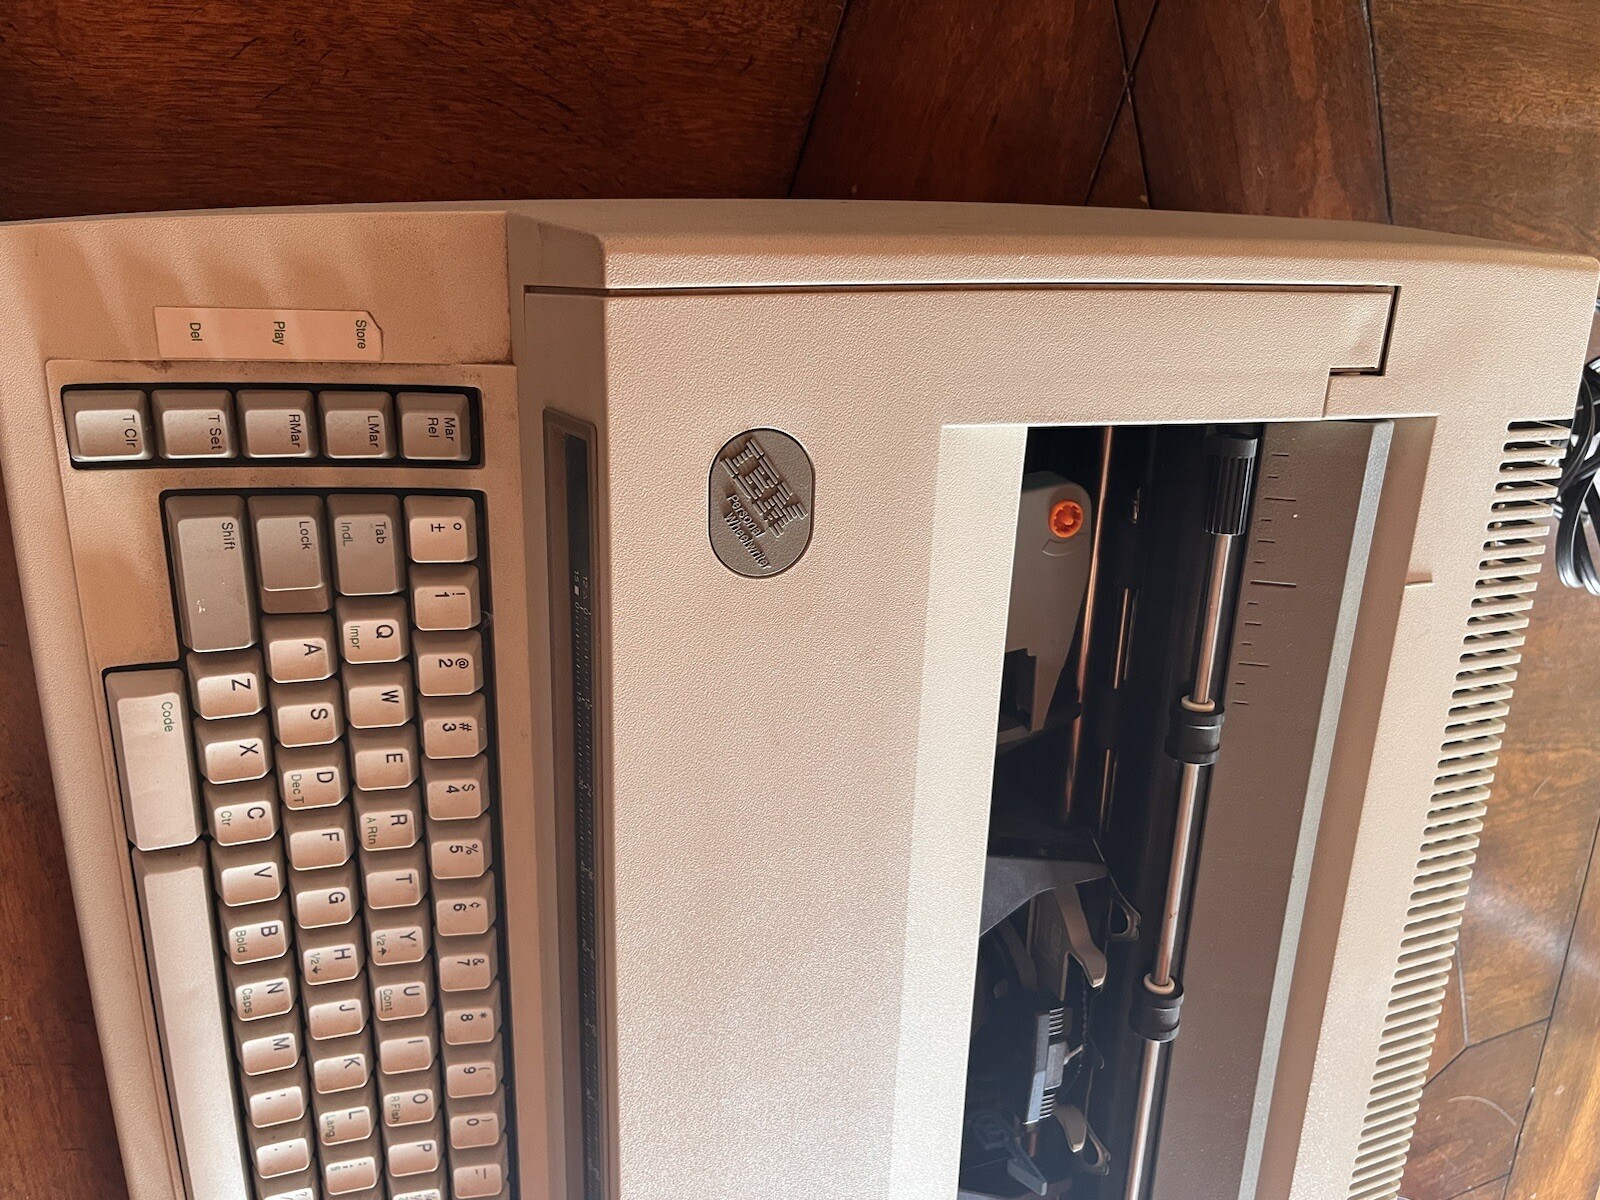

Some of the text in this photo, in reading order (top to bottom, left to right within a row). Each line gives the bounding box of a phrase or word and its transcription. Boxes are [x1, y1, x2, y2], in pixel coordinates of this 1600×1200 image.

[189, 322, 201, 342] Del
[273, 321, 285, 346] Play
[355, 319, 367, 349] Store
[123, 414, 138, 448] T Clr
[208, 414, 222, 450] T Set
[289, 414, 301, 448] RMar
[367, 415, 380, 448] LMar
[428, 417, 438, 439] Rel
[444, 417, 456, 442] Mar
[720, 438, 809, 538] IBM
[726, 494, 766, 538] Personal
[222, 522, 236, 551] Shift
[298, 521, 312, 550] Lock
[341, 522, 353, 547] IndL
[375, 522, 387, 544] Tab
[724, 512, 772, 570] Wheelwriter
[434, 591, 450, 599] 1
[349, 625, 361, 650] Impr
[375, 624, 394, 639] Q
[303, 643, 321, 656] A
[438, 658, 453, 668] 2
[455, 658, 469, 669] @
[231, 678, 252, 691] Z
[381, 690, 399, 704] W
[161, 702, 174, 732] Code
[310, 708, 328, 720] S
[442, 723, 457, 732] 3
[459, 722, 472, 732] #
[239, 744, 259, 757] X
[386, 753, 403, 764] E
[316, 771, 335, 784] D
[291, 774, 305, 805] Dec T
[446, 785, 460, 794] 4
[461, 783, 475, 792] $
[220, 810, 233, 827] Ctr
[246, 806, 266, 820] C
[390, 814, 408, 826] R
[321, 832, 340, 842] F
[367, 826, 379, 845] Rtn
[449, 845, 463, 854] 5
[465, 843, 478, 855] %
[253, 866, 272, 878] V
[395, 873, 412, 884] T
[328, 891, 346, 904] G
[453, 903, 467, 912] 6
[260, 925, 279, 937] B
[399, 931, 417, 942] Y
[235, 930, 248, 954] Bold
[334, 948, 352, 960] H
[457, 958, 470, 966] 7
[473, 958, 485, 966] &
[266, 982, 284, 995] N
[403, 985, 420, 997] U
[240, 988, 253, 1014] Caps
[382, 989, 394, 1012] Cont
[339, 1004, 354, 1013] J
[460, 1013, 474, 1022] 8
[272, 1037, 290, 1051] M
[343, 1057, 361, 1070] K
[463, 1066, 477, 1075] 9
[348, 1110, 364, 1120] L
[325, 1115, 337, 1138] Lang
[466, 1118, 480, 1126] 0
[417, 1143, 432, 1152] P
